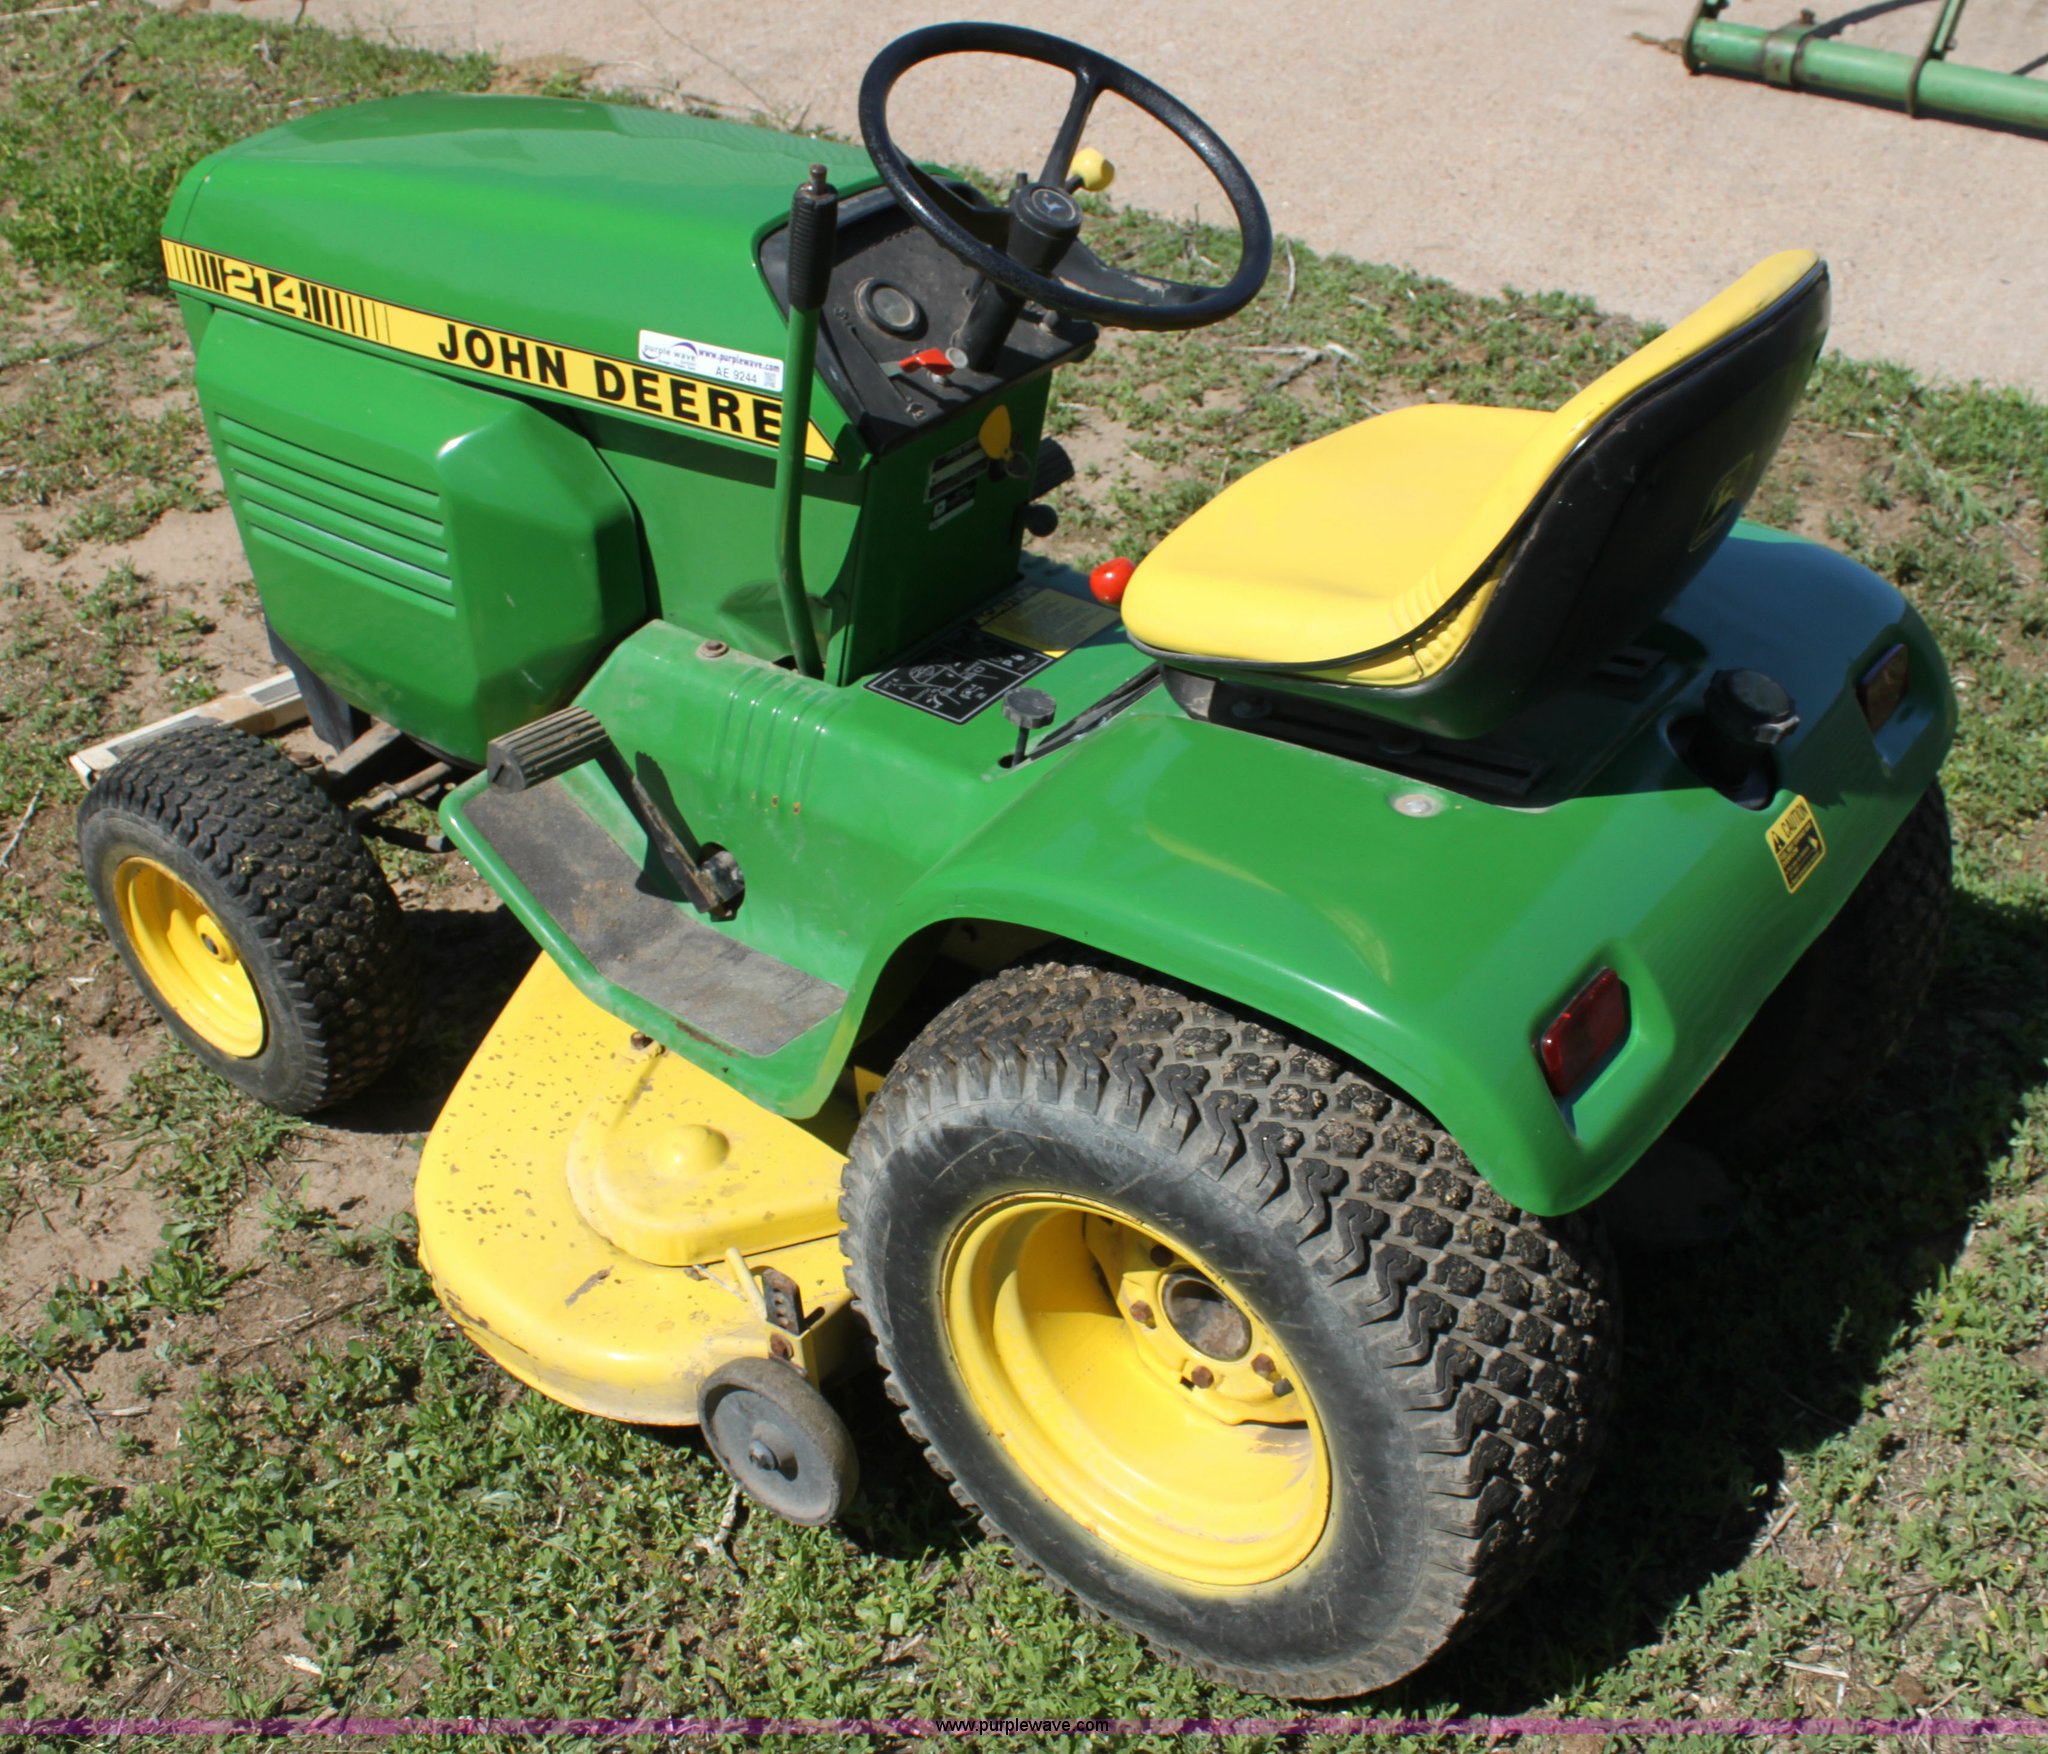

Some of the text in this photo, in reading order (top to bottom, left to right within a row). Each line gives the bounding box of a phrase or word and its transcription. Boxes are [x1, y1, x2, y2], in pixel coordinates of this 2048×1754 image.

[222, 258, 308, 318] 214
[674, 350, 697, 362] wave
[698, 348, 780, 372] www.purplewave.com
[438, 323, 783, 444] JOHN DEERE
[715, 366, 758, 384] AE 9244
